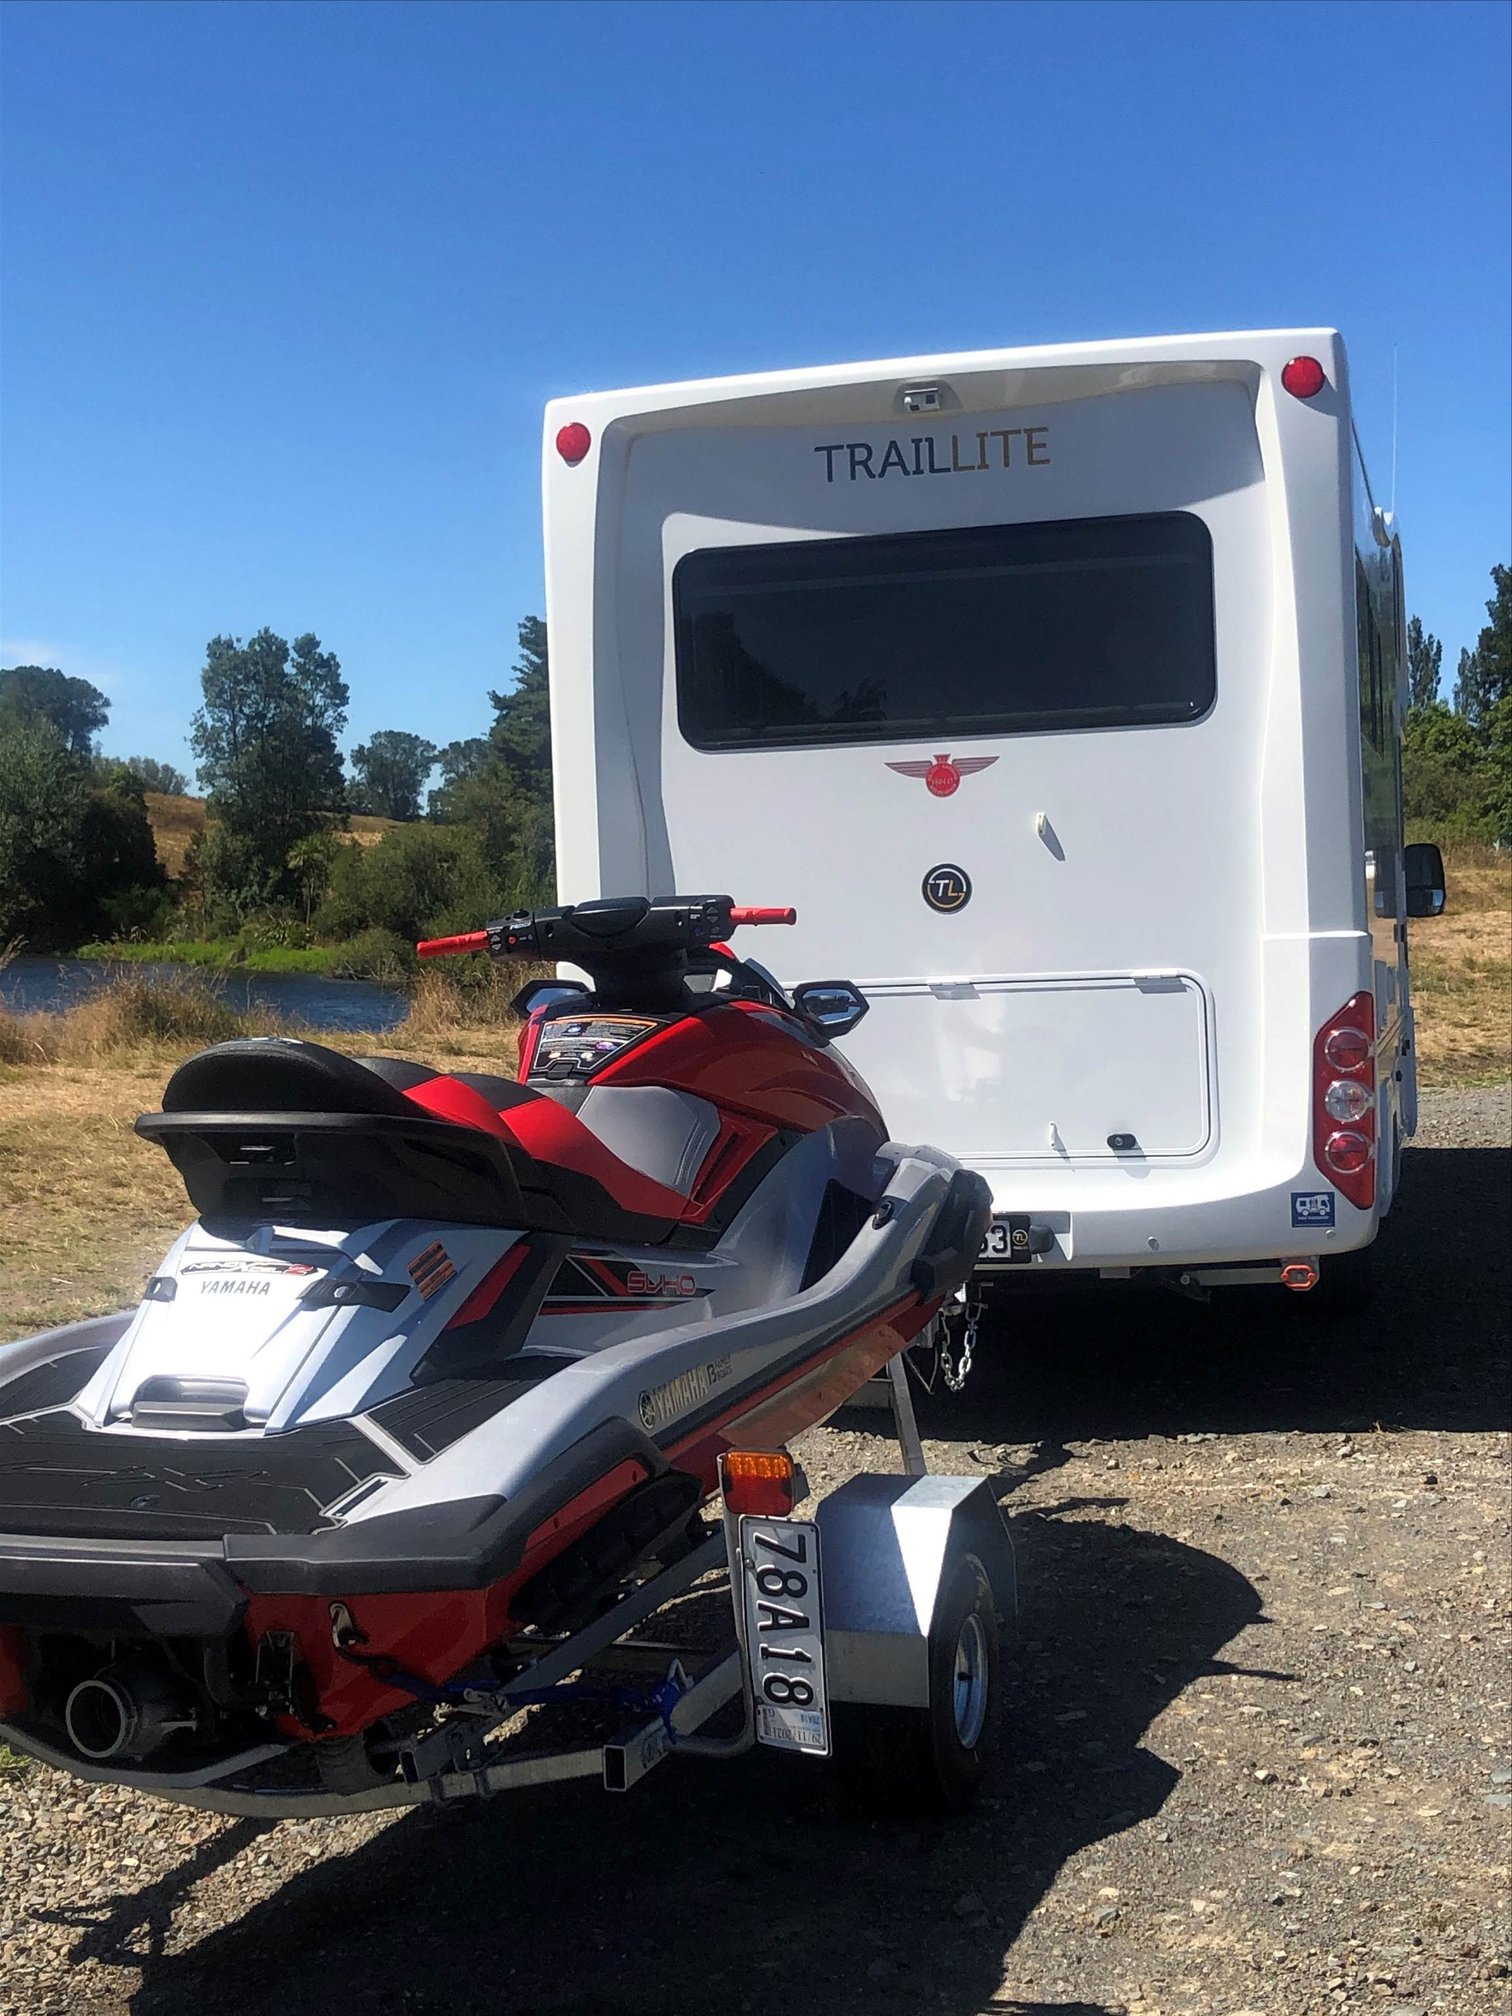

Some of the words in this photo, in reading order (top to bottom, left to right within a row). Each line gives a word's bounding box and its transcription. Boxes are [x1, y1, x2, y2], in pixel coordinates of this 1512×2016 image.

[814, 427, 1051, 483] TRAILLITE
[200, 1279, 272, 1296] YAMAHA
[627, 1270, 696, 1296] SVHO
[654, 1365, 708, 1420] YAMAHA
[753, 1531, 814, 1706] 78A18
